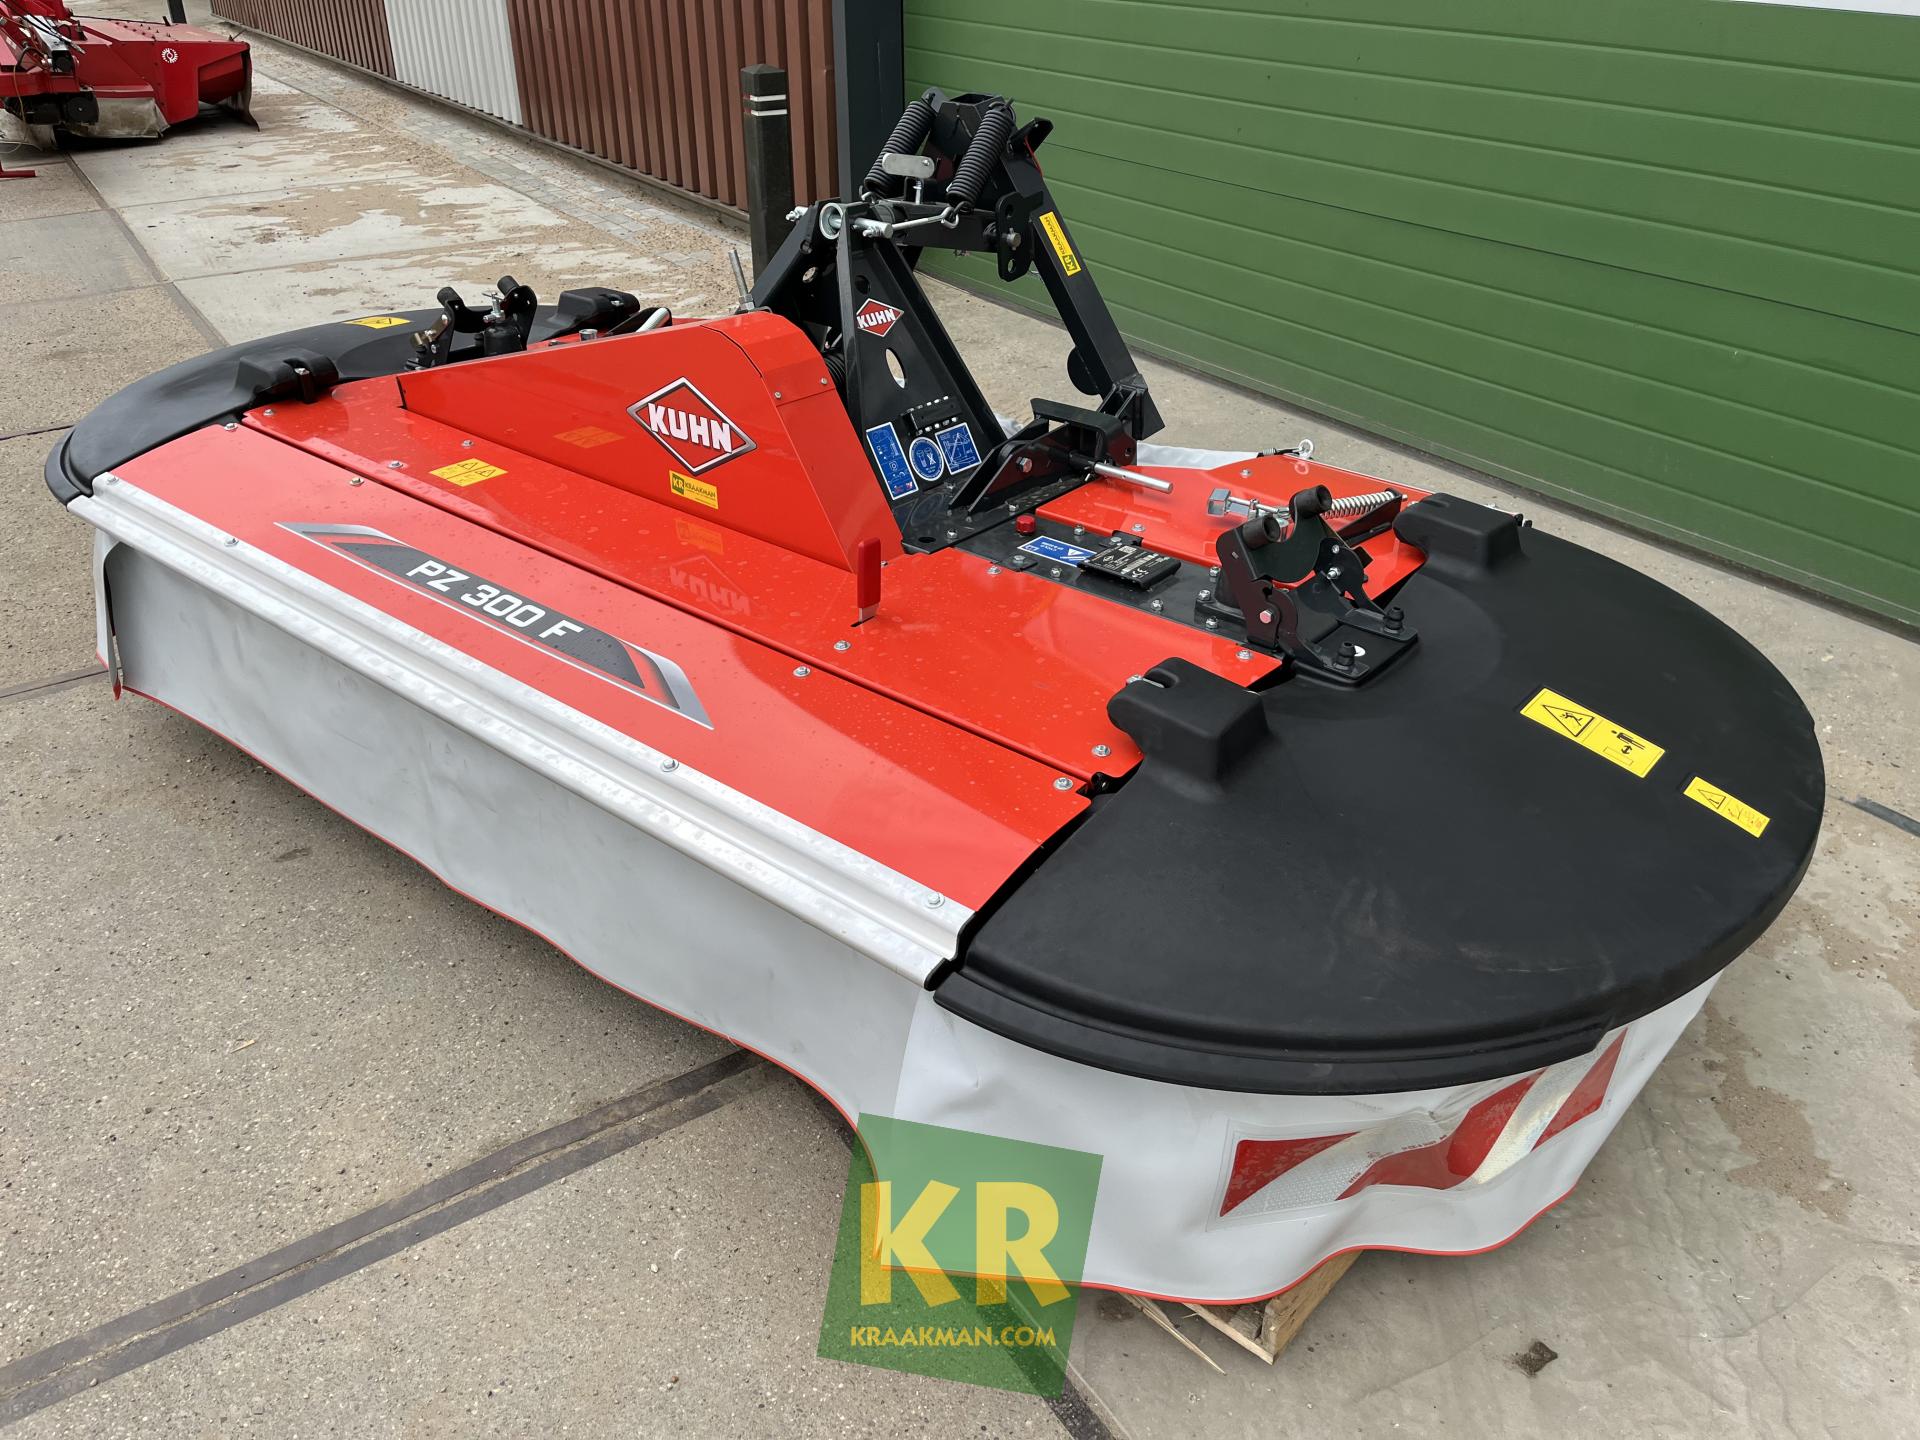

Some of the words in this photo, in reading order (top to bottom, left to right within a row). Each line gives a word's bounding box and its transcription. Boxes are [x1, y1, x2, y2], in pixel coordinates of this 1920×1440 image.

[1064, 255, 1078, 271] KR
[857, 308, 897, 330] KUHN
[648, 402, 732, 453] KUHN
[406, 560, 471, 592] PZ
[460, 584, 546, 628] 300
[538, 619, 585, 639] F
